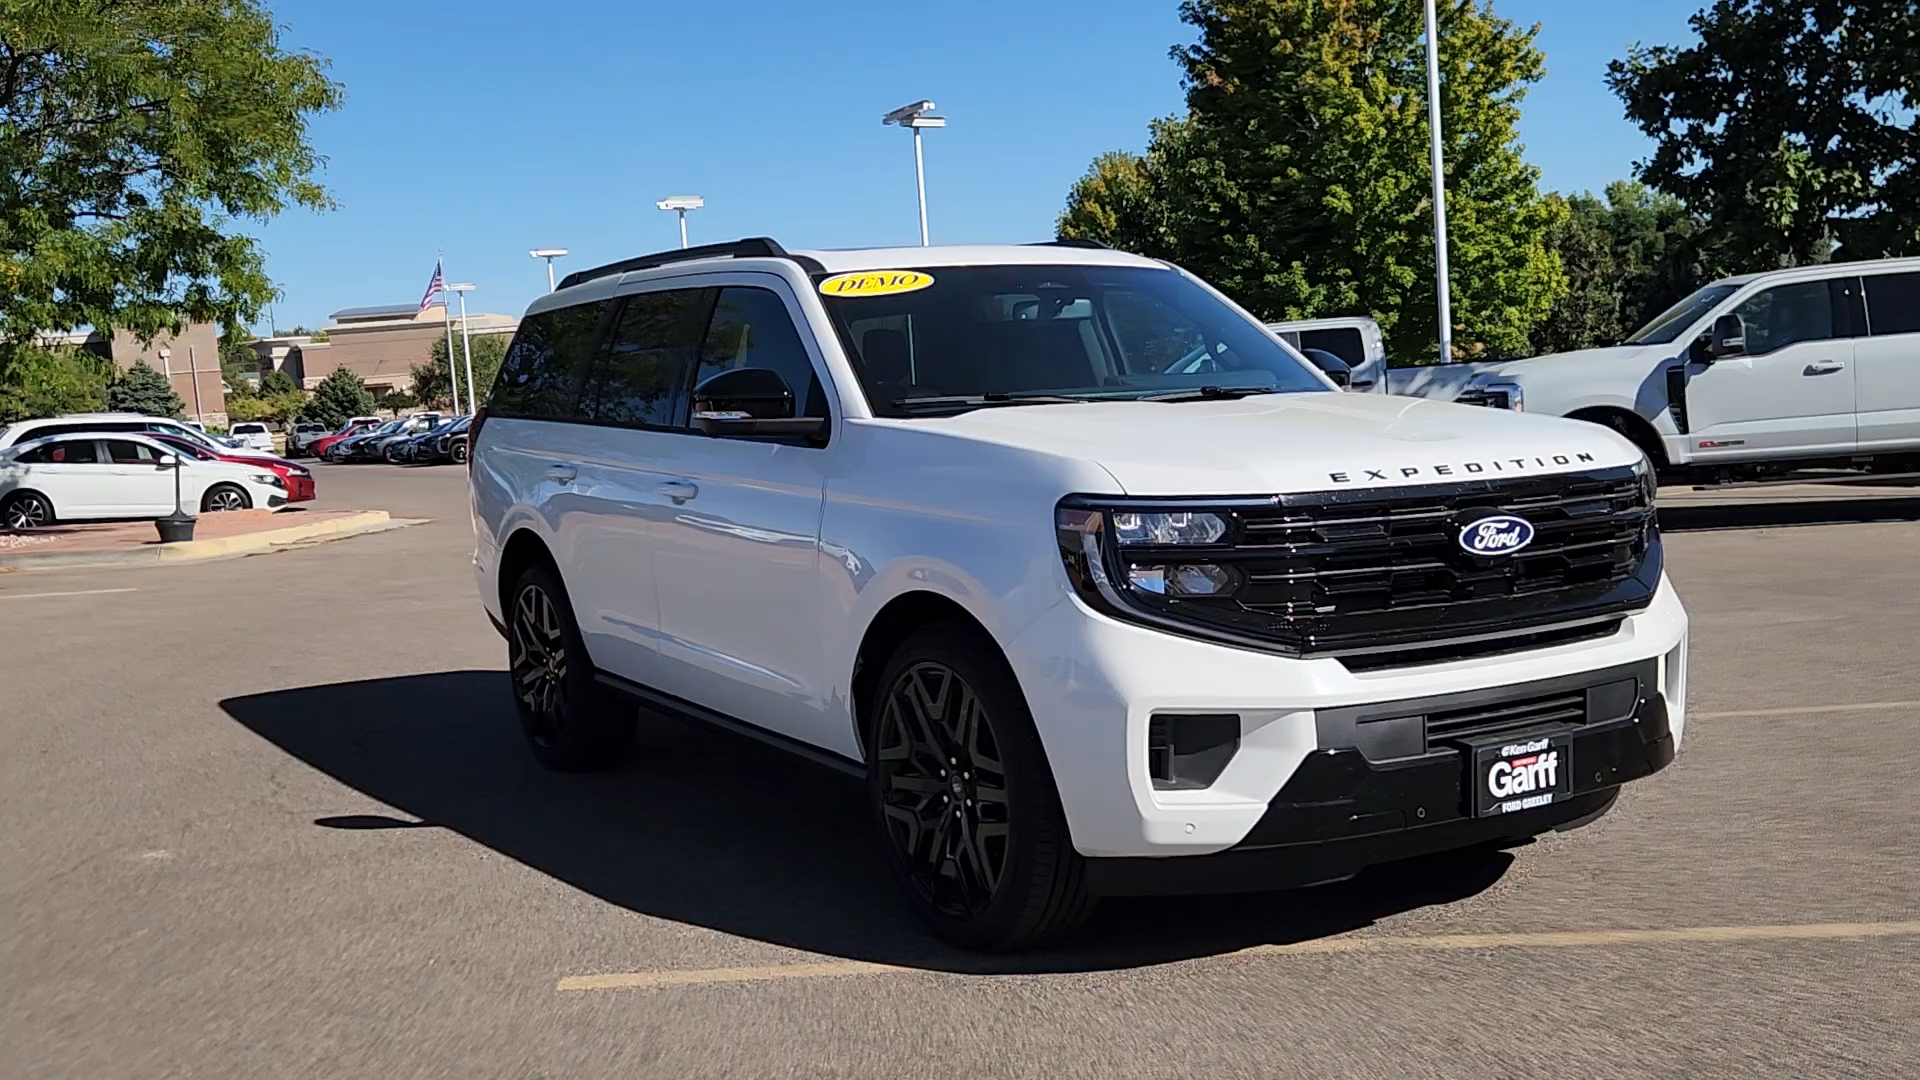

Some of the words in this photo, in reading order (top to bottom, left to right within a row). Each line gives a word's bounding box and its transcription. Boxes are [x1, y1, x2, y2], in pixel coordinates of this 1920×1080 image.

[836, 274, 919, 292] DEMO
[1328, 452, 1596, 483] EXPEDITION
[1474, 521, 1521, 550] Ford
[1510, 744, 1527, 756] Ken
[1527, 738, 1549, 752] Garff
[1488, 751, 1557, 798] Garff
[1502, 800, 1521, 813] FORD
[1522, 793, 1553, 809] GREELEY
